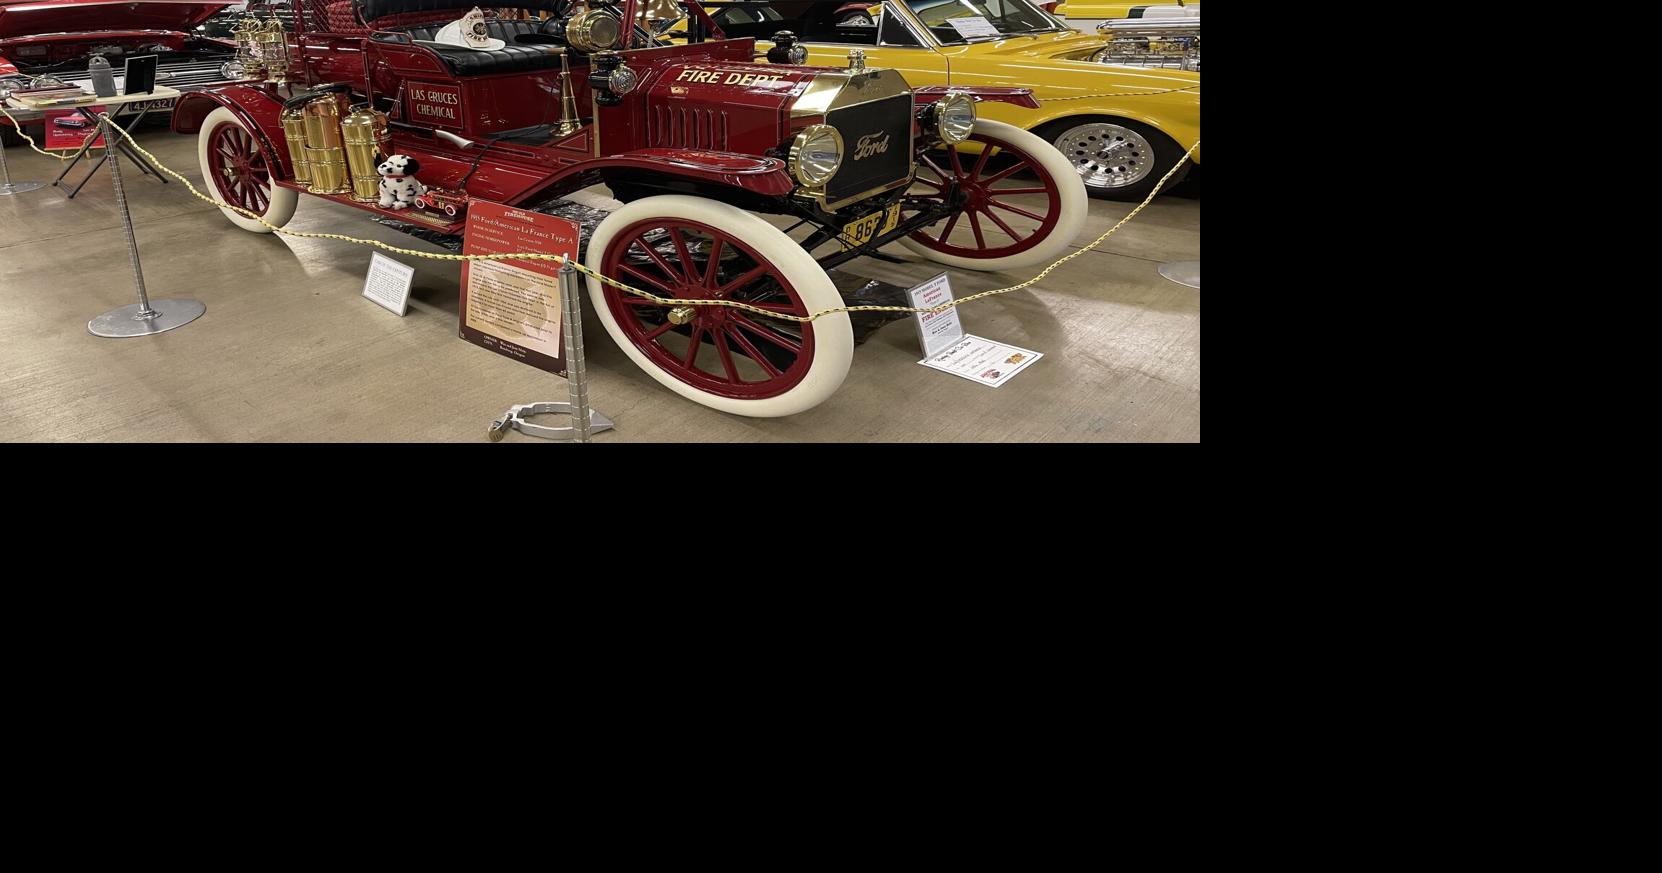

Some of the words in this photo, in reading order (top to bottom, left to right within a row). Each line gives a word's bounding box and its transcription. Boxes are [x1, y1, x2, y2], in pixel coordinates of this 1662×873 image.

[676, 69, 724, 85] FIRE
[723, 72, 784, 88] DEPT
[411, 89, 426, 101] LAS
[427, 91, 458, 105] CRUCES
[416, 104, 456, 120] CHEMICAL
[853, 130, 890, 160] Ford
[521, 226, 529, 235] La
[529, 228, 549, 240] France
[551, 232, 566, 244] Type
